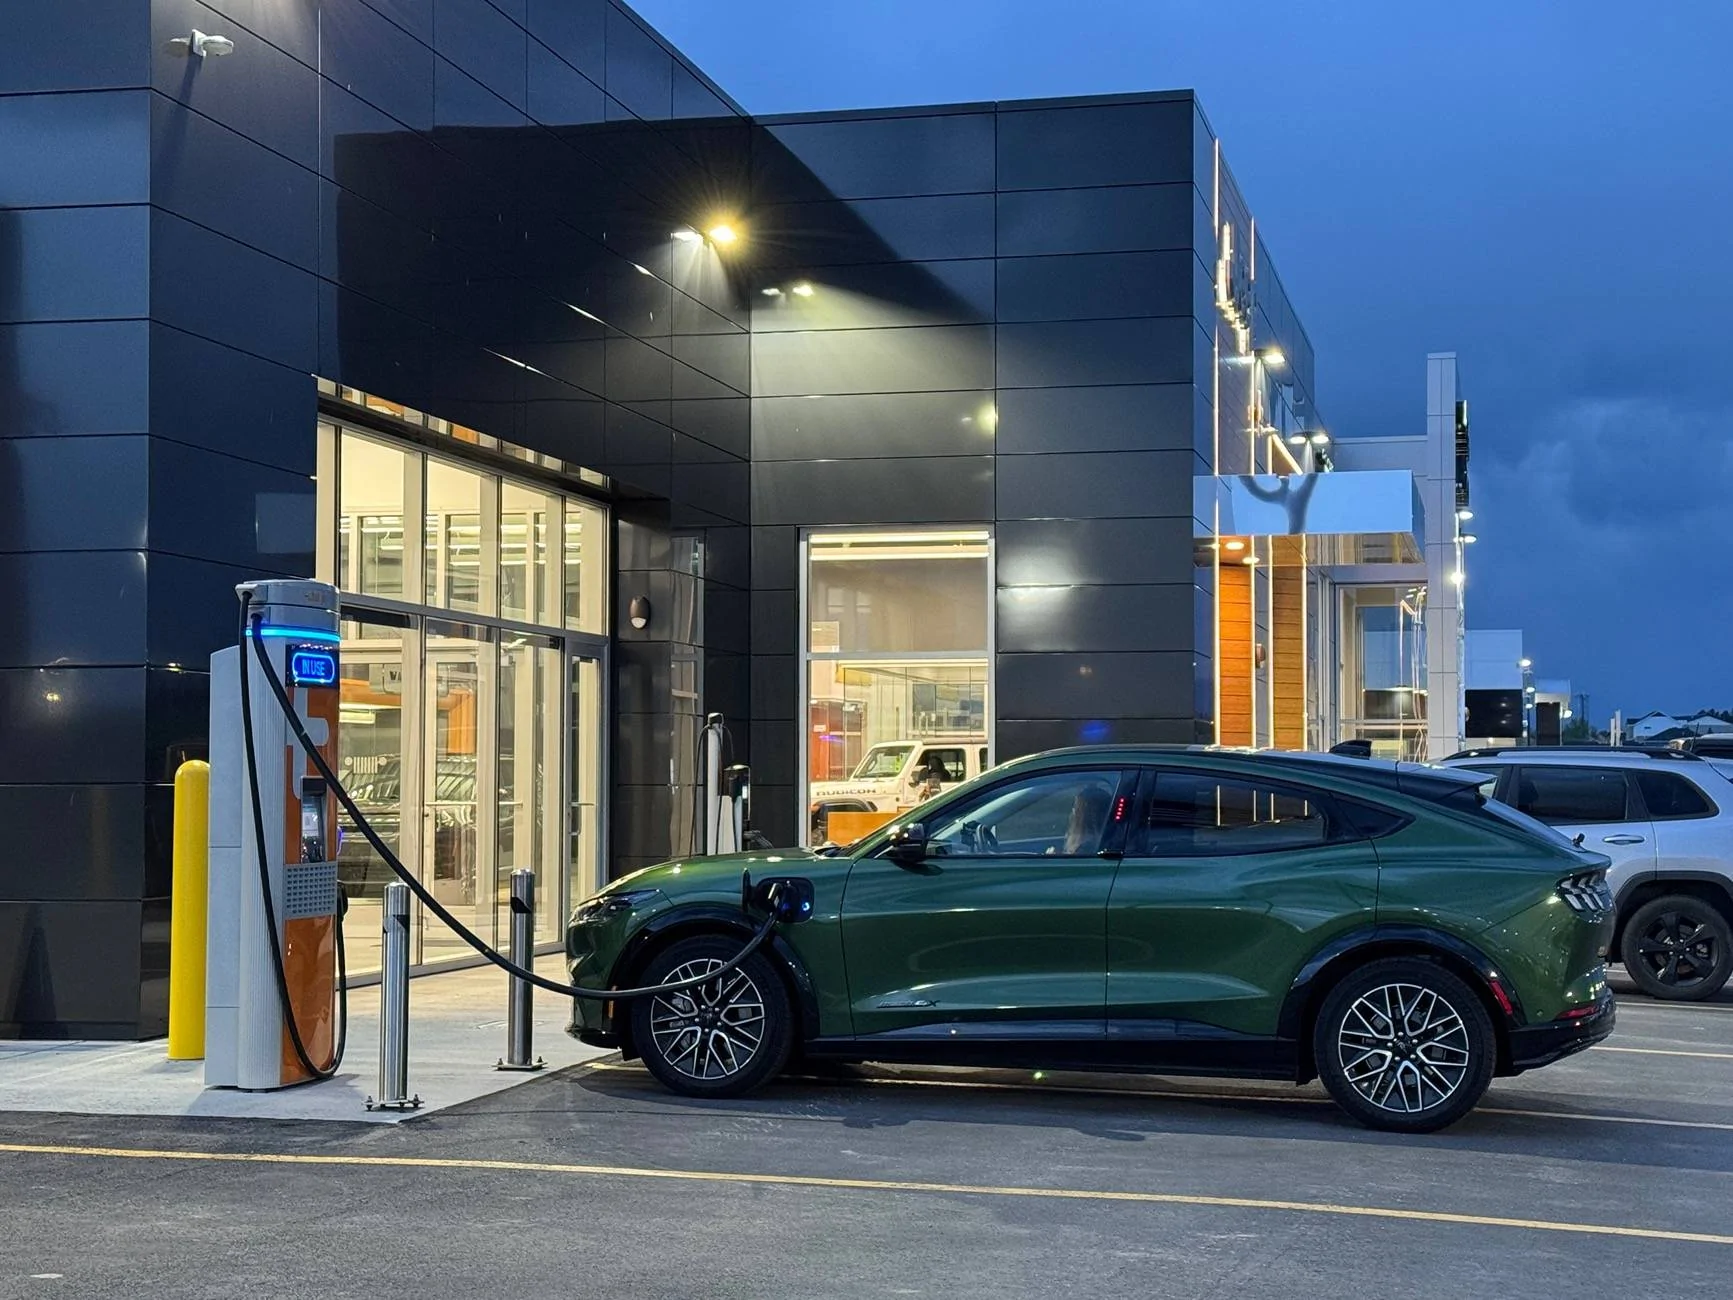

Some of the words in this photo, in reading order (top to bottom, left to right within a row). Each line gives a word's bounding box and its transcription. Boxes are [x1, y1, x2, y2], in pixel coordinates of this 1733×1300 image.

[302, 659, 310, 675] IN
[310, 660, 325, 676] USE
[816, 788, 877, 796] RUBICON
